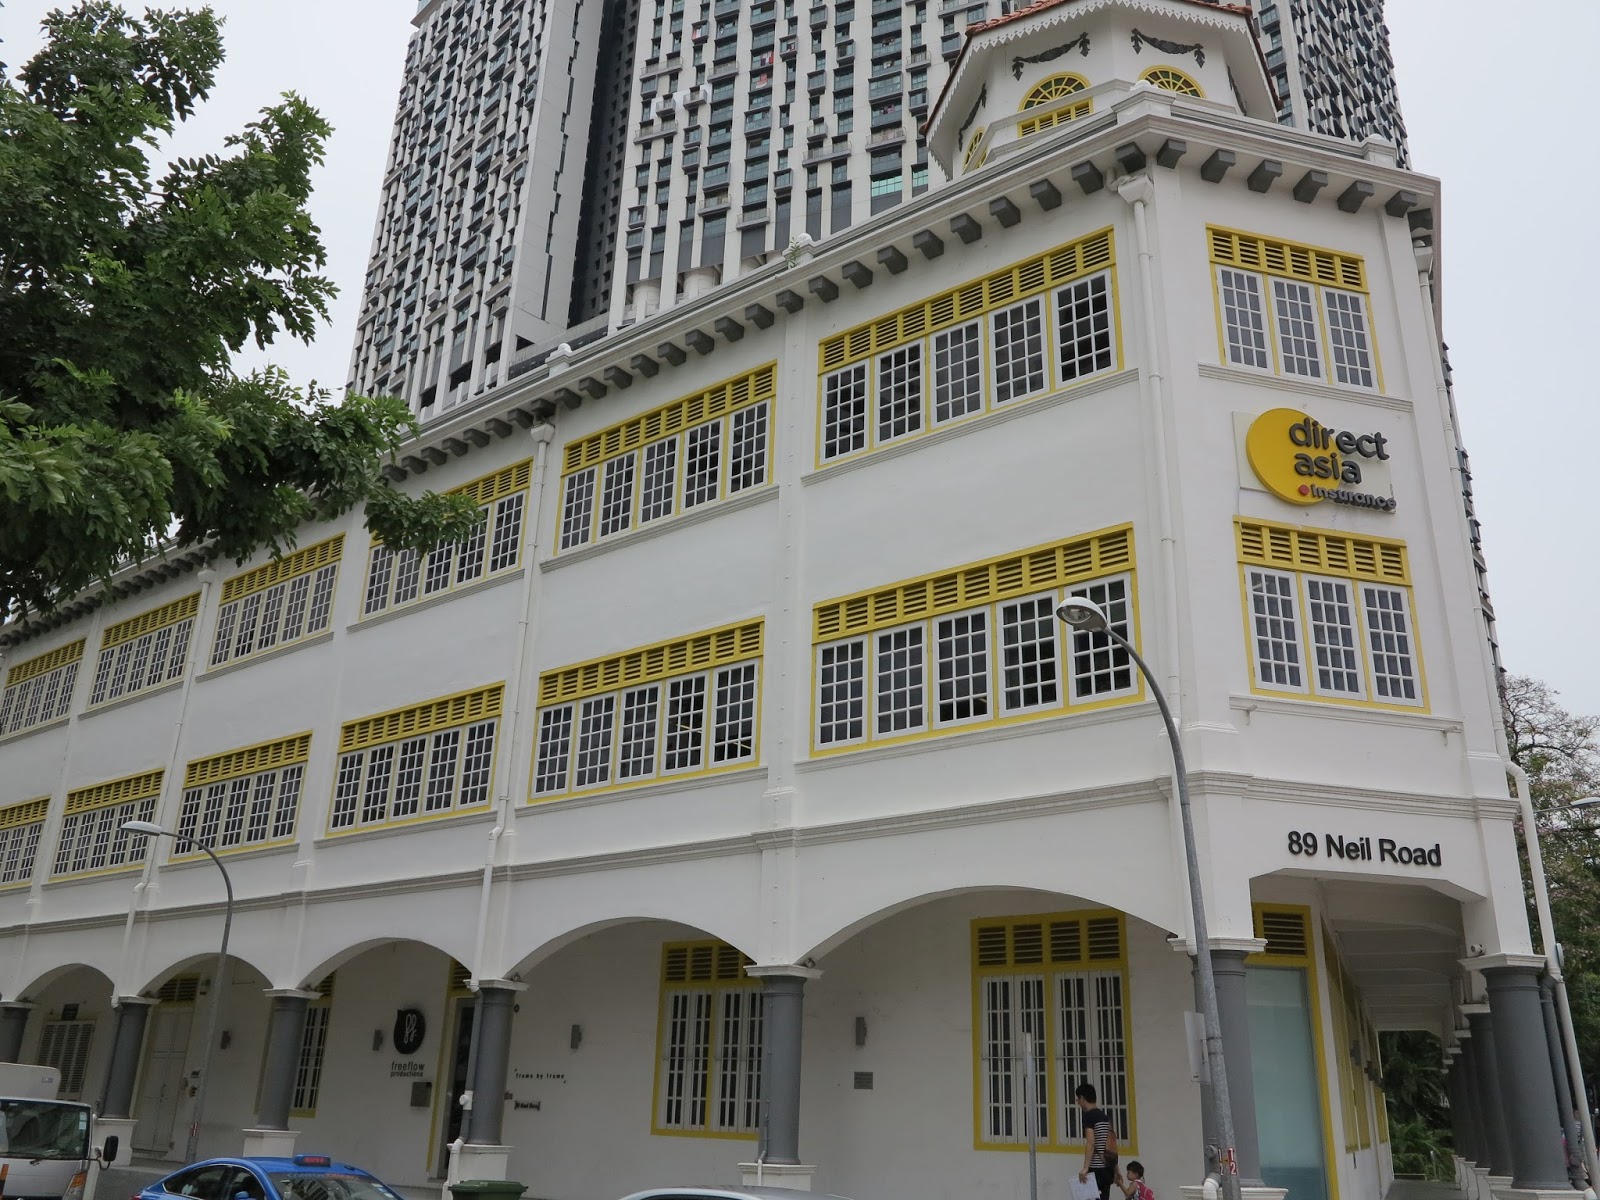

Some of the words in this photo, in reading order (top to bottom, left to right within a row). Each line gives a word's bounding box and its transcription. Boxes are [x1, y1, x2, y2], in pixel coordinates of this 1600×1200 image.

[1289, 417, 1390, 461] direct
[1294, 452, 1362, 484] asia
[1311, 483, 1397, 511] insurance
[1287, 831, 1318, 856] 89
[1325, 834, 1372, 861] Neil
[1378, 838, 1442, 867] Road
[391, 1061, 425, 1071] freeflow
